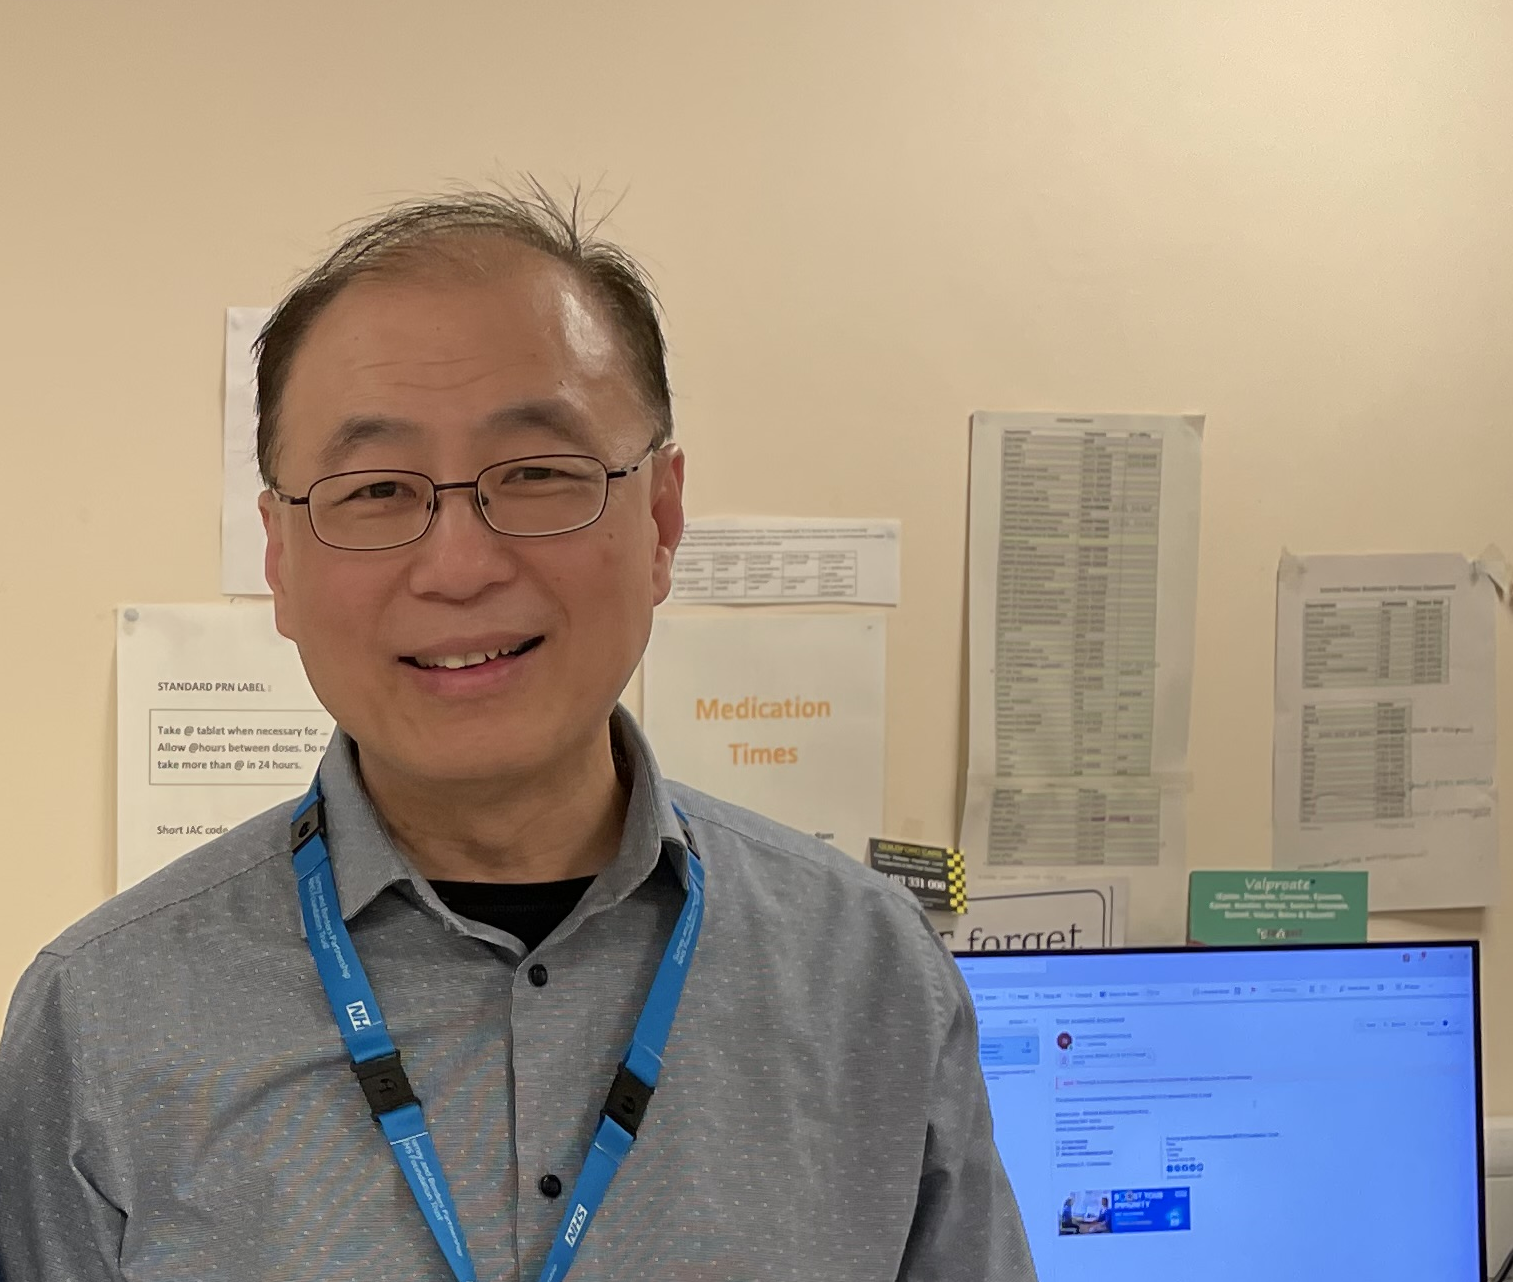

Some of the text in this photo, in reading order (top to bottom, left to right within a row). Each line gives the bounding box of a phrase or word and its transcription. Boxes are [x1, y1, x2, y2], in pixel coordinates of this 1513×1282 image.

[157, 682, 265, 693] STANDARD PRN LABEL
[695, 696, 831, 720] Medication
[157, 725, 318, 737] Take @ tablet when necessary for
[157, 742, 186, 752] Allow
[228, 743, 270, 753] between
[303, 743, 317, 752] Do
[728, 742, 798, 765] Times
[157, 760, 302, 771] take more than @ in 24 hours.
[157, 825, 184, 835] Short
[186, 826, 203, 835] JAC
[1244, 877, 1311, 894] Valproate
[346, 1002, 371, 1031] NH
[565, 1204, 588, 1248] NHS
